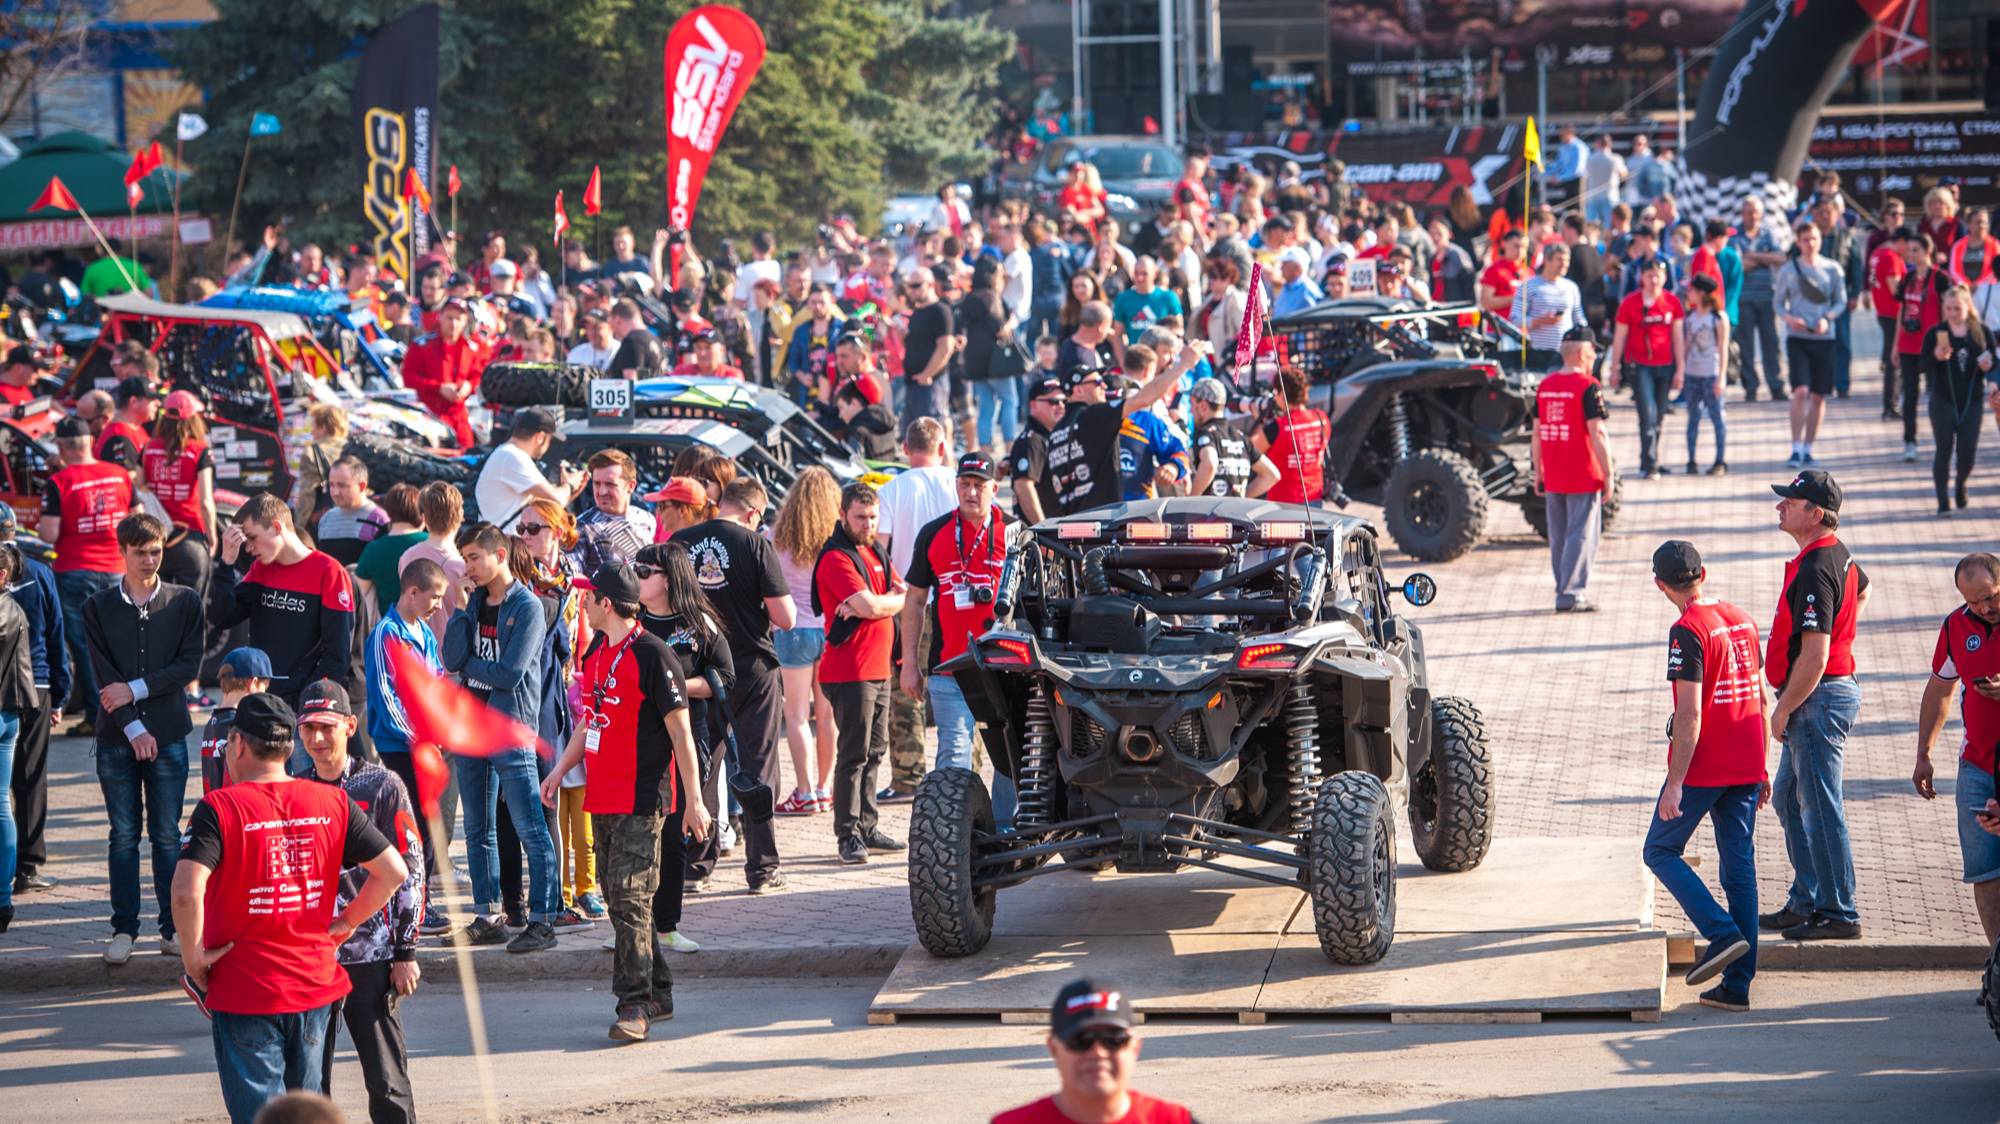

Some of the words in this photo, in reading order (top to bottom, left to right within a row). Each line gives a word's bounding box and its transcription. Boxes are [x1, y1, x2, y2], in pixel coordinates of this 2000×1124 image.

[671, 14, 729, 147] SSV
[697, 49, 744, 152] Standard
[1344, 162, 1443, 183] can-am
[364, 107, 409, 284] XPS
[594, 389, 626, 406] 305
[261, 590, 306, 613] adidas
[244, 816, 331, 831] canamxrace.ru
